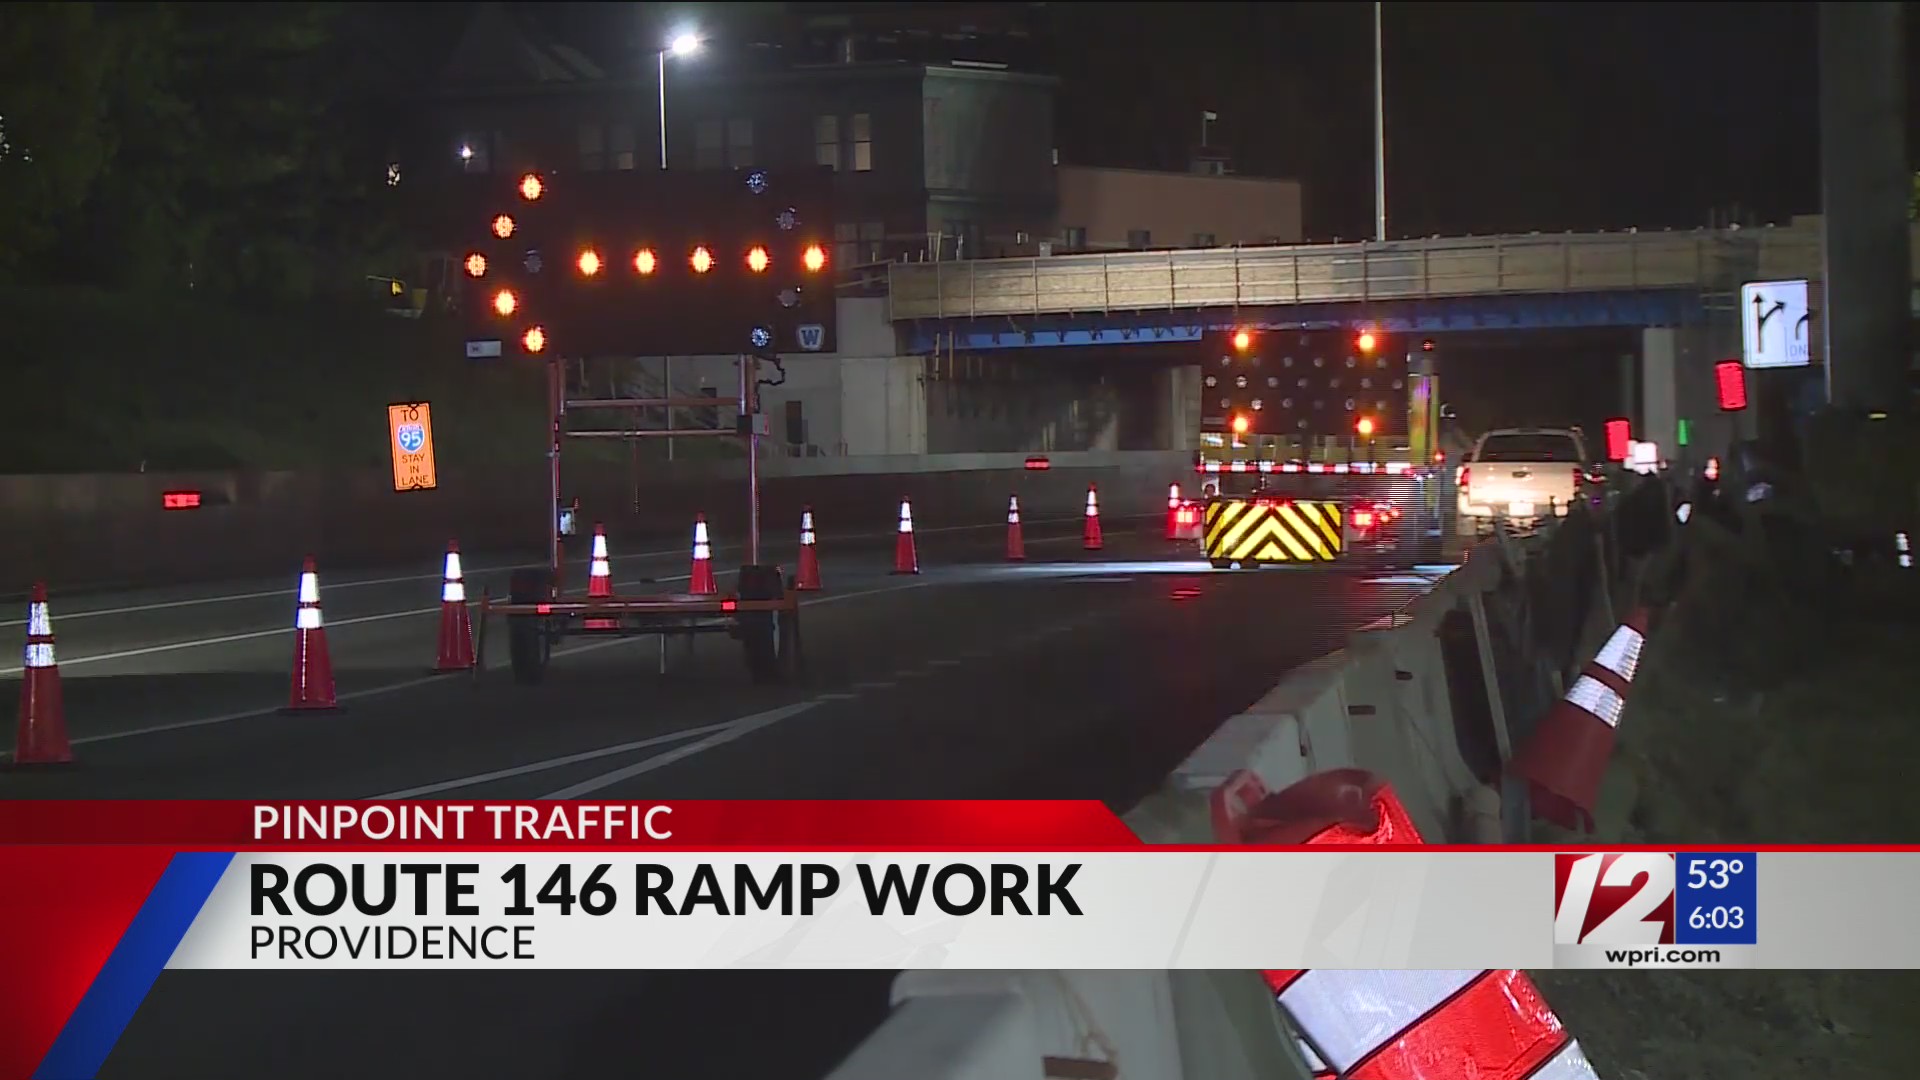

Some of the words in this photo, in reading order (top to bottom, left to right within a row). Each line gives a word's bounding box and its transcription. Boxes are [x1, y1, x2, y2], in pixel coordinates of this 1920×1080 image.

[401, 409, 419, 421] TO
[401, 432, 421, 447] 95
[402, 454, 425, 464] STAY
[410, 465, 420, 474] IN
[401, 475, 429, 485] LANE
